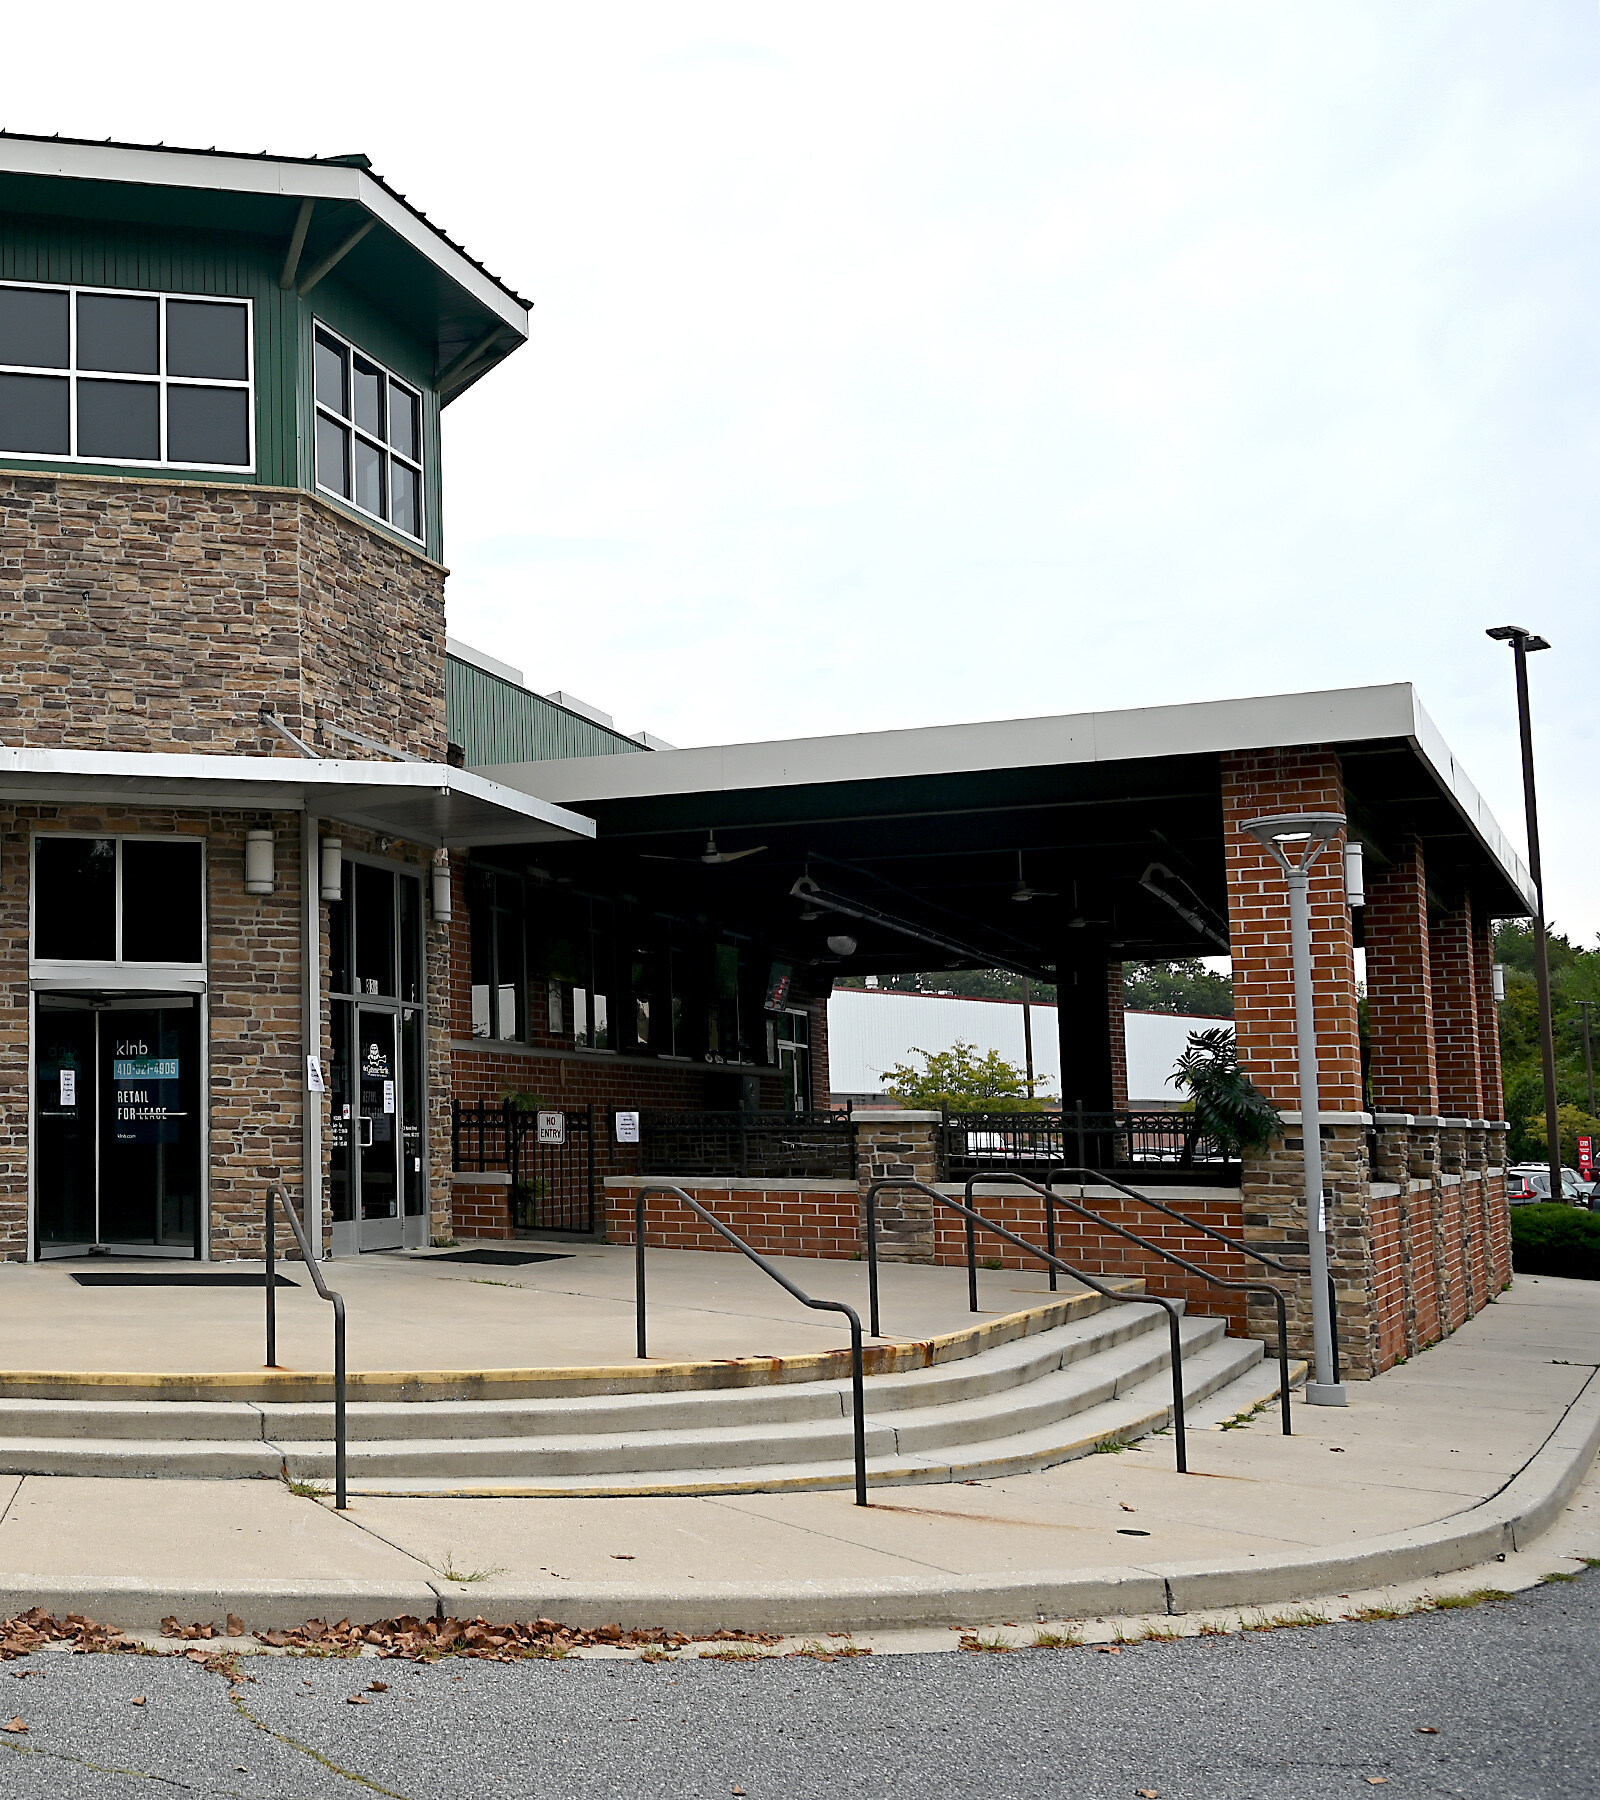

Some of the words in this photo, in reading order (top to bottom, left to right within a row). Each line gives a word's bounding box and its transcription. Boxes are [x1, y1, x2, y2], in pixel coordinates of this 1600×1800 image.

[117, 1040, 148, 1055] klnb
[117, 1091, 149, 1103] RETAIL
[117, 1107, 136, 1120] FOR
[139, 1107, 167, 1120] LEASE
[540, 1128, 562, 1139] ENTRY
